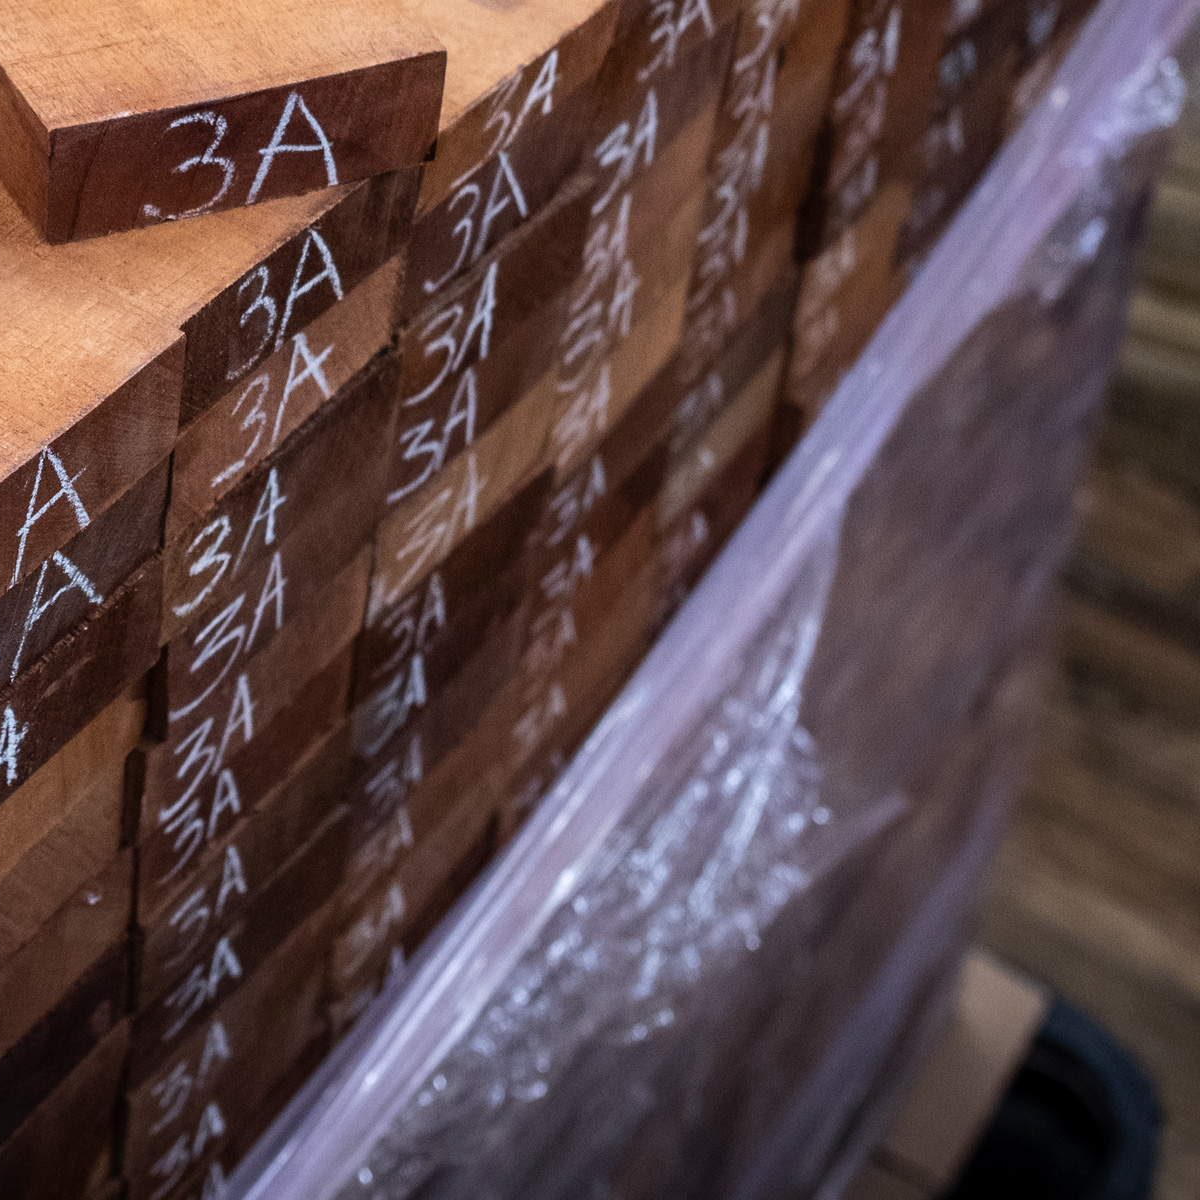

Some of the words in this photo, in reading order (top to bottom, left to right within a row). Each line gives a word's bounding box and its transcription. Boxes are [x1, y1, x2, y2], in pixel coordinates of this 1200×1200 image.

[143, 91, 338, 221] 3A
[451, 49, 558, 189] 3A
[591, 88, 658, 216] 3A
[423, 152, 528, 293] 3A
[226, 228, 343, 381] 3A
[403, 261, 497, 407] 3A
[556, 259, 642, 394] 3A
[211, 332, 334, 488] 3A
[387, 367, 477, 504] 3A
[171, 468, 287, 616] 3A
[385, 452, 490, 605] 3A
[168, 550, 288, 722] 3A
[159, 674, 255, 821] 3A
[156, 768, 240, 886] 3A
